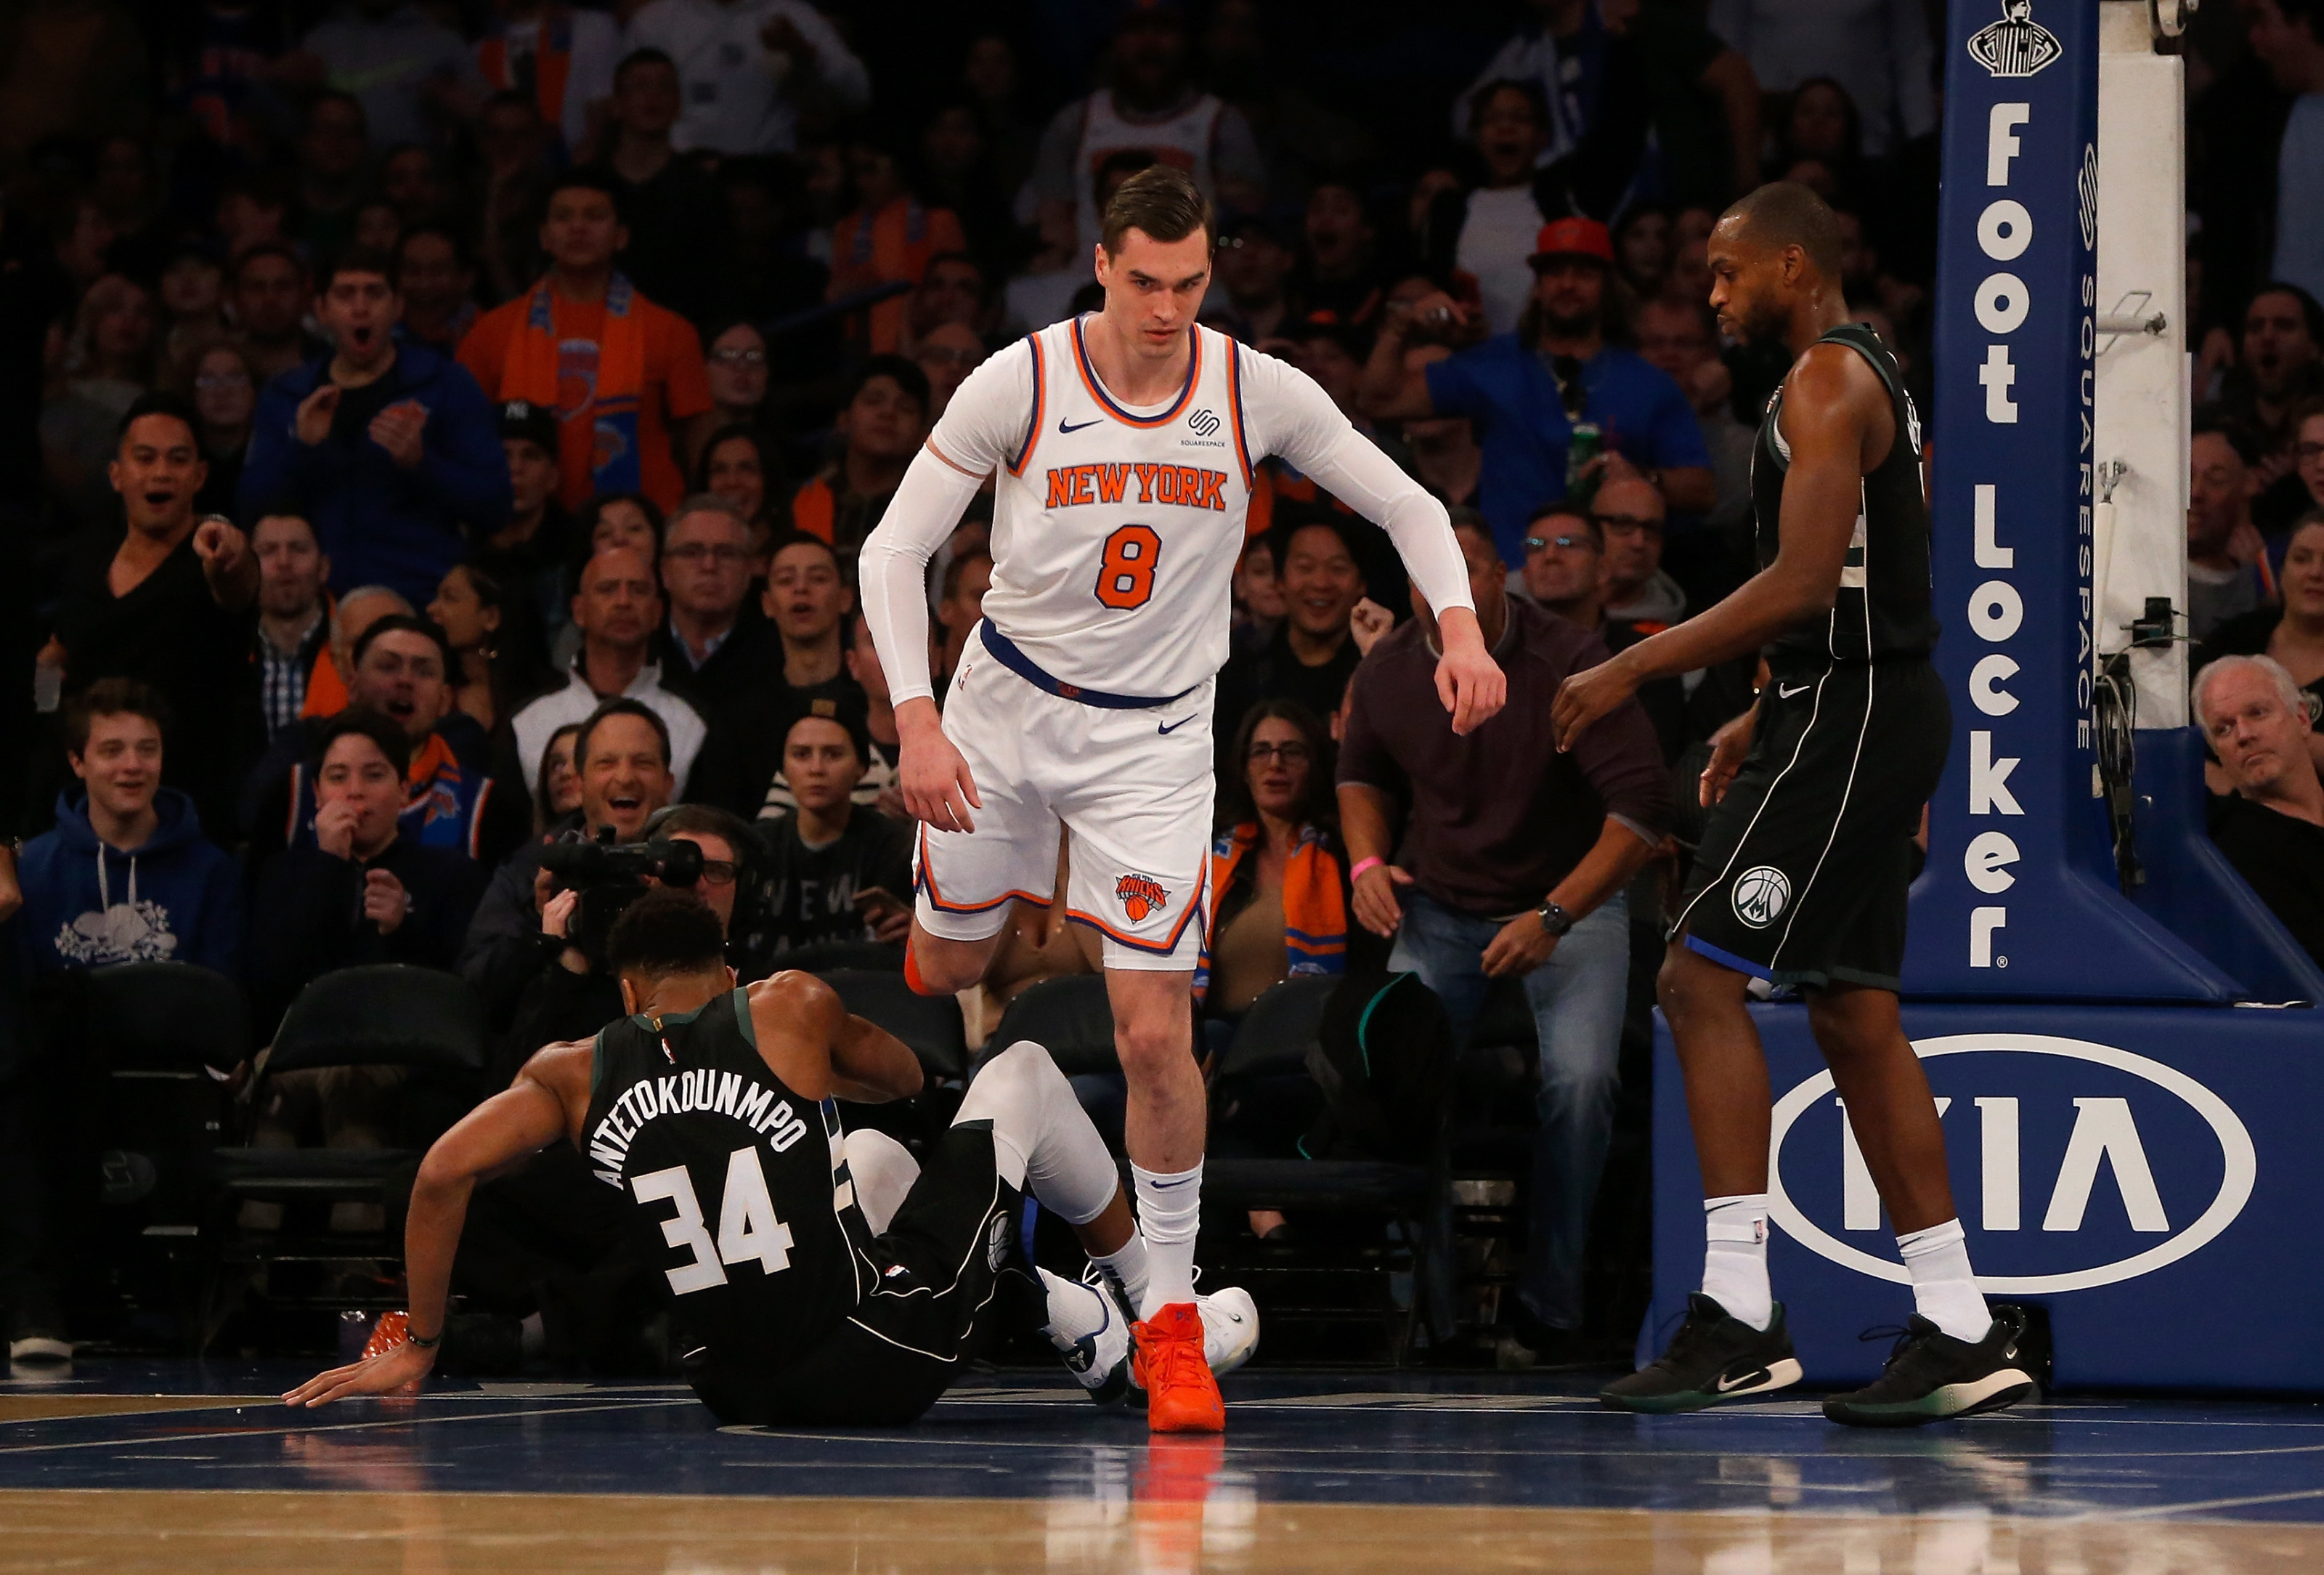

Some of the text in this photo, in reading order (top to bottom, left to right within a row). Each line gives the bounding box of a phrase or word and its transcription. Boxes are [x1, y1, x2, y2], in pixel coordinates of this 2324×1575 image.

[1046, 463, 1227, 511] NEW YORK
[2077, 274, 2095, 749] SQUARESPACE
[1094, 524, 1163, 611] 8
[1116, 875, 1166, 907] KNICKS
[590, 1069, 807, 1191] ANTETOKOUNMPO
[630, 1146, 795, 1295] 34
